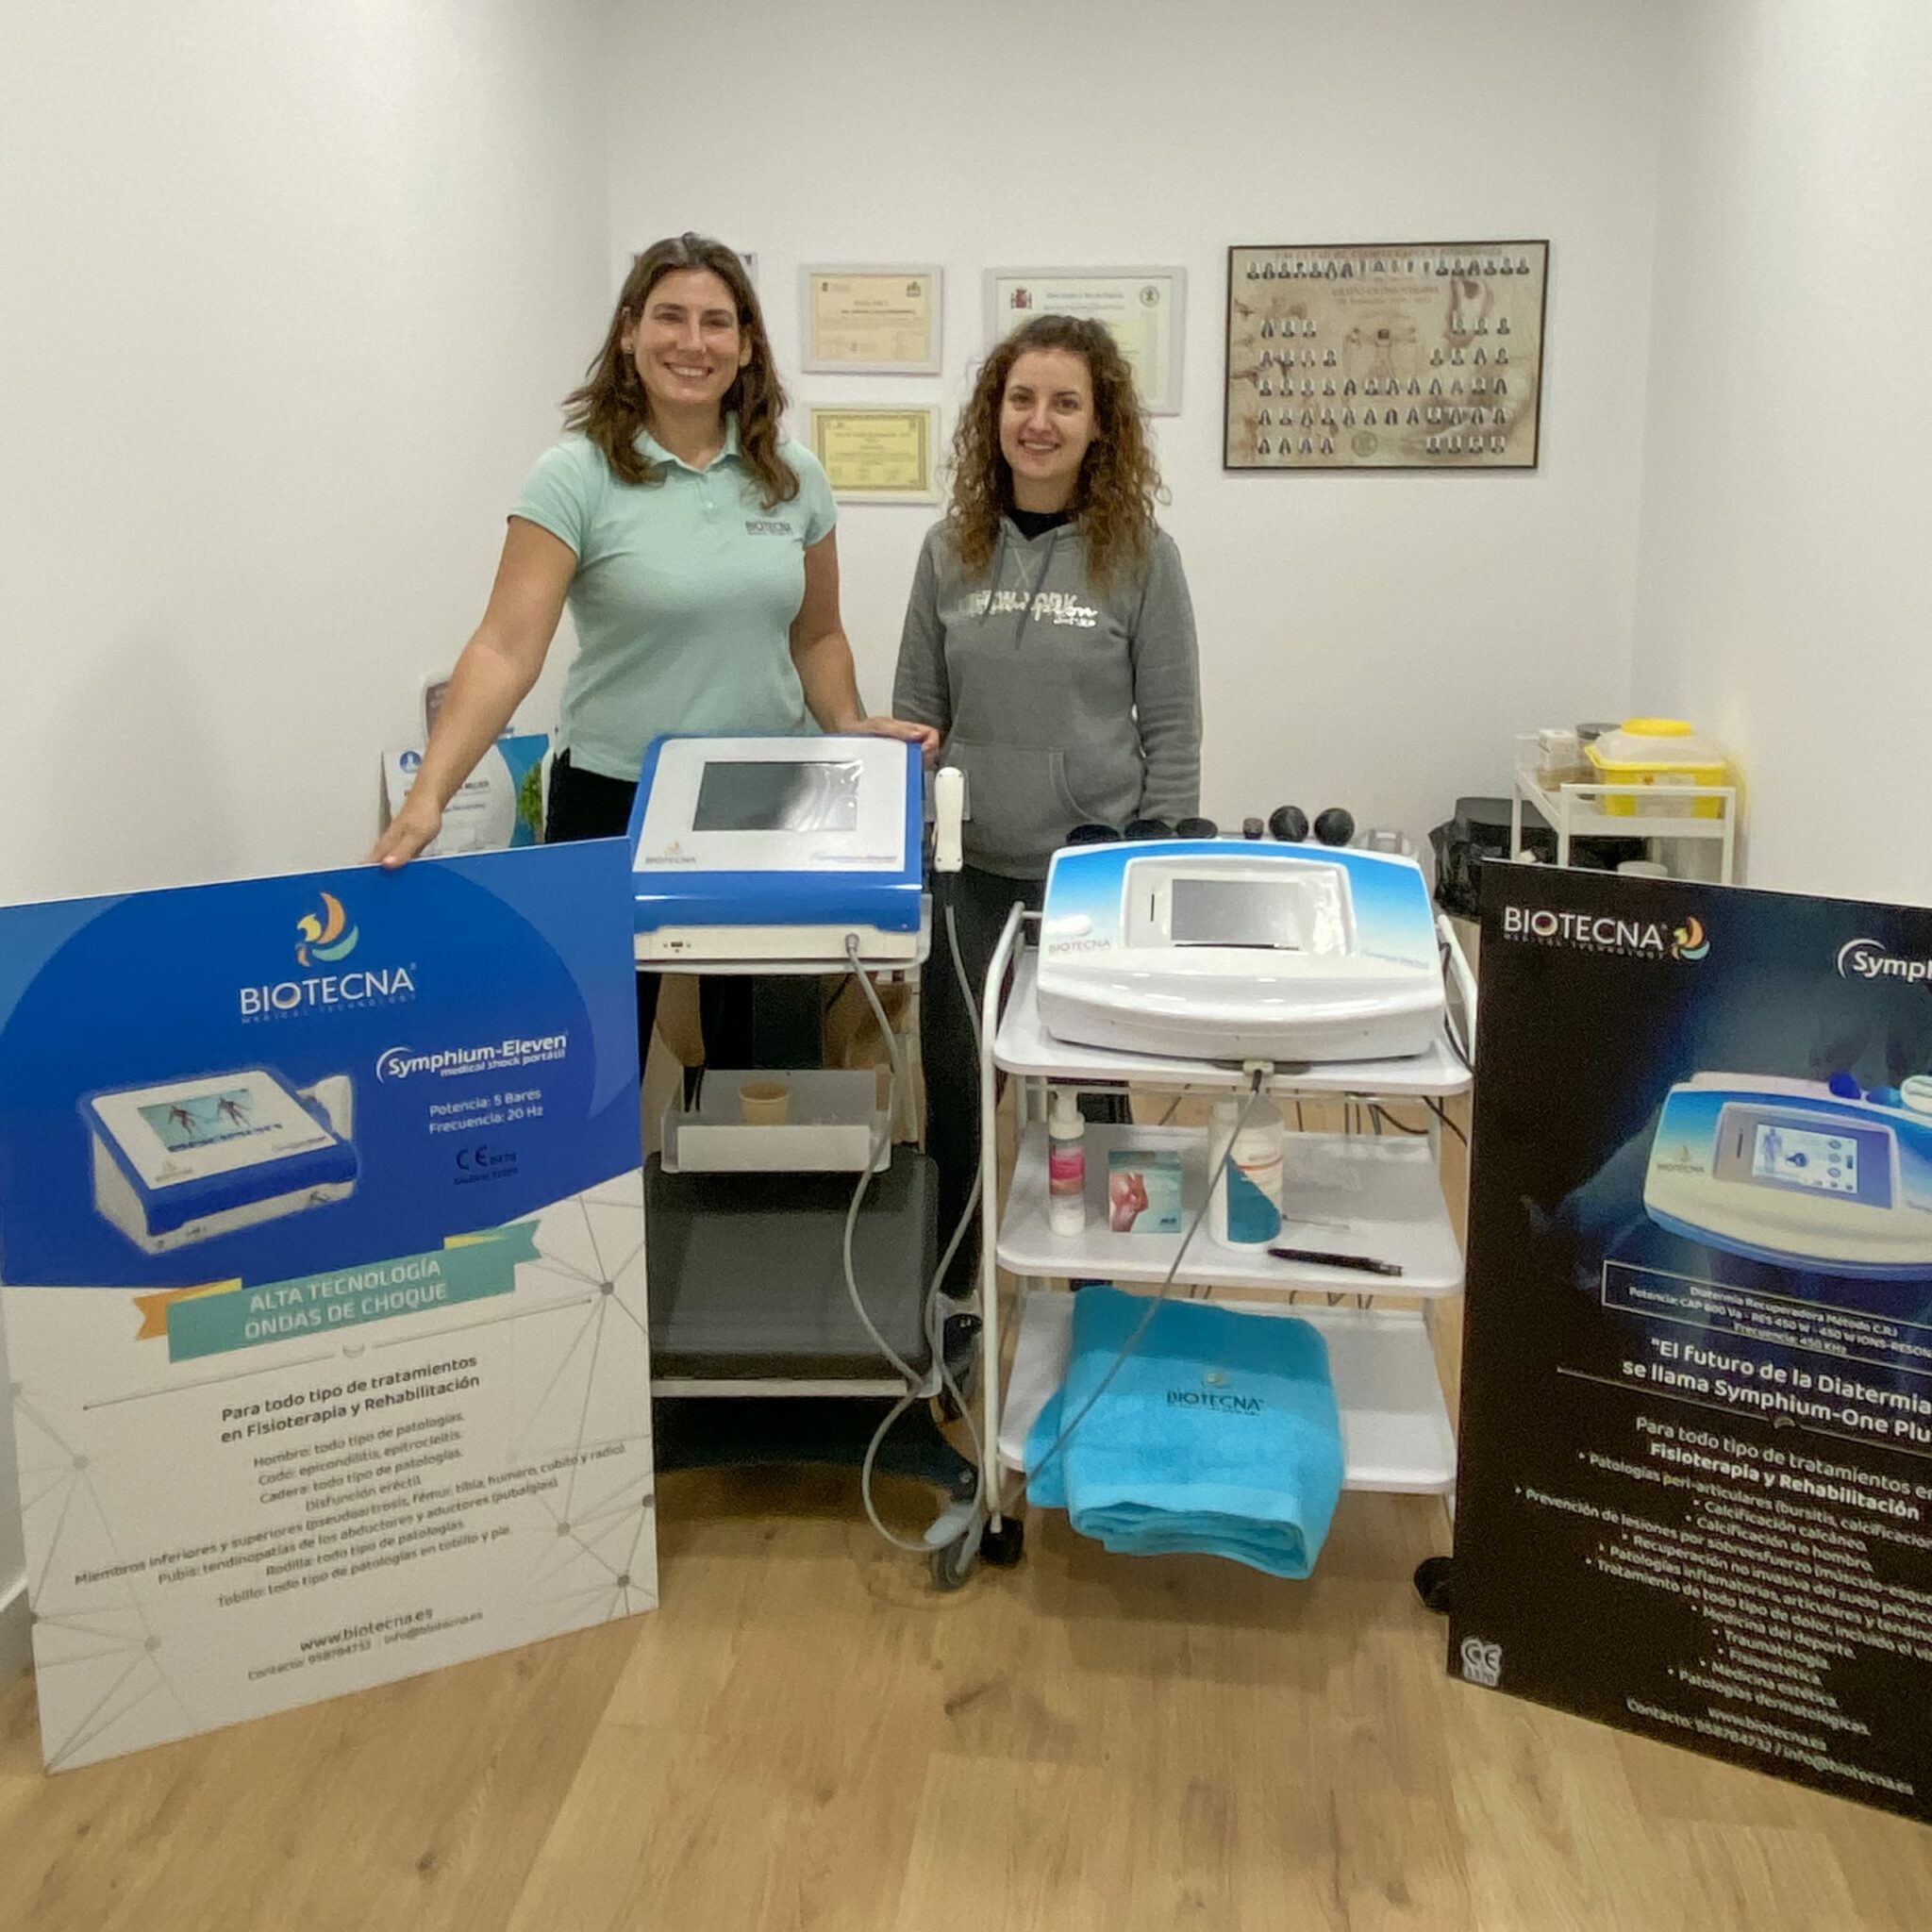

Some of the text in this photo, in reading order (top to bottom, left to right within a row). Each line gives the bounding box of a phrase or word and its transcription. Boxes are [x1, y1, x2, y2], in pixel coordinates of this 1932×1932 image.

[1504, 906, 1664, 952] BIOTECNA
[240, 967, 415, 1015] BIOTECNA
[388, 1034, 567, 1078] Symphium-Eleven
[429, 1089, 541, 1117] Potencia: 5 Bares
[429, 1113, 505, 1134] Frecuencia:
[507, 1108, 524, 1122] 20
[243, 1282, 447, 1341] ONDAS DE CHOQUE
[249, 1257, 441, 1313] ALTA TECNOLOGÍA
[221, 1374, 480, 1443] en Fisioterapia y Rehabilitación
[222, 1356, 477, 1422] Para todo tipo de tratamientos
[1622, 1359, 1932, 1442] se llama Symphium-One Plu
[1759, 1362, 1788, 1385] de
[1791, 1367, 1812, 1390] la
[1818, 1373, 1932, 1415] Diatermia
[314, 1438, 345, 1456] todo
[377, 1425, 393, 1441] de
[1636, 1416, 1674, 1439] Para
[1678, 1426, 1719, 1449] todo
[1723, 1438, 1759, 1458] tipo
[1762, 1448, 1786, 1463] de
[1790, 1453, 1911, 1495] tratamientos
[375, 1464, 391, 1478] de
[1651, 1442, 1921, 1522] Fisioterapia y Rehabilitación
